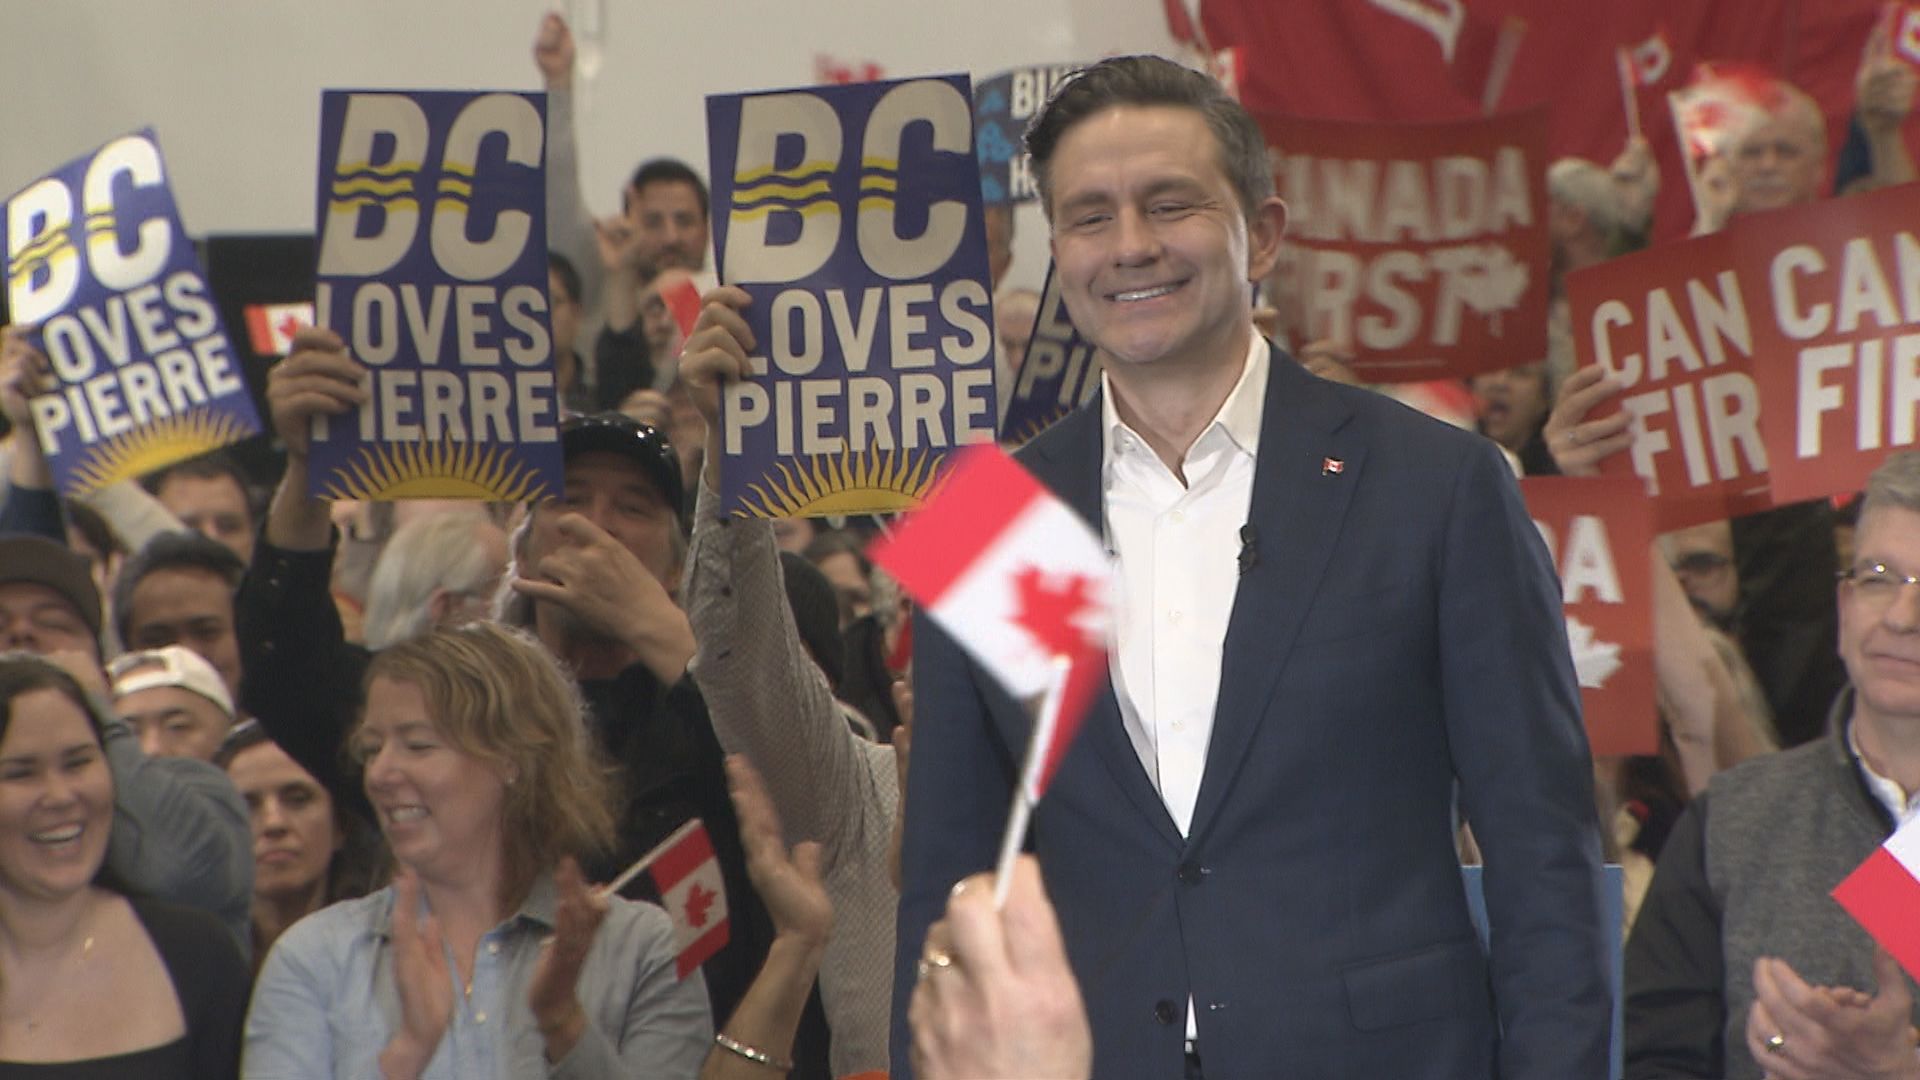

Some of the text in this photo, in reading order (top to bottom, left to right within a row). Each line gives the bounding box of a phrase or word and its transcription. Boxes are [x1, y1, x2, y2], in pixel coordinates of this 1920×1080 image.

[8, 135, 173, 326] BC
[317, 93, 545, 281] BC
[723, 78, 972, 284] BC
[1268, 147, 1534, 241] ANADA
[42, 271, 217, 390] OVES
[31, 334, 242, 455] PIERRE
[312, 368, 558, 442] IERRE
[725, 369, 994, 455] PIERRE
